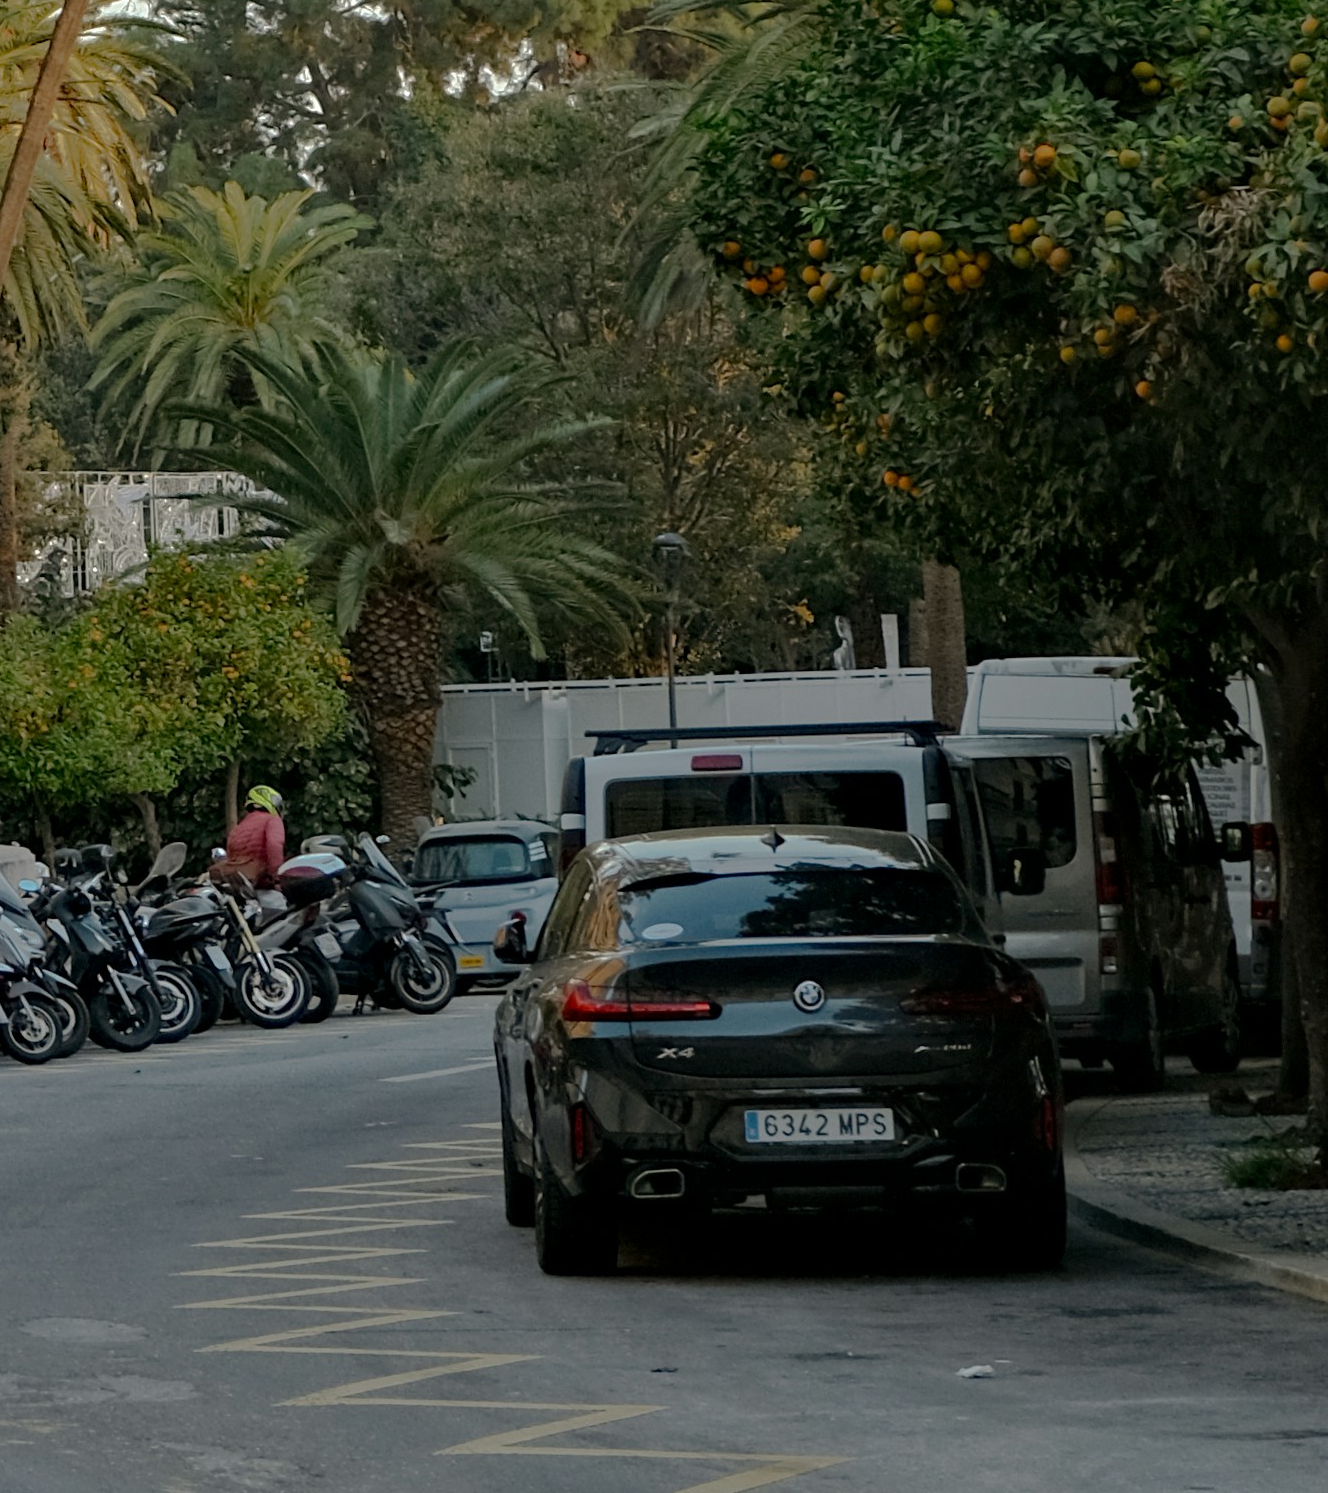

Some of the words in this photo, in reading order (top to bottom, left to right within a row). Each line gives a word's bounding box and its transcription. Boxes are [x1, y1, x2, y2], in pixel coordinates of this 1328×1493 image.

[656, 1047, 696, 1059] X4
[764, 1113, 829, 1137] 6342
[839, 1112, 887, 1136] MPS
